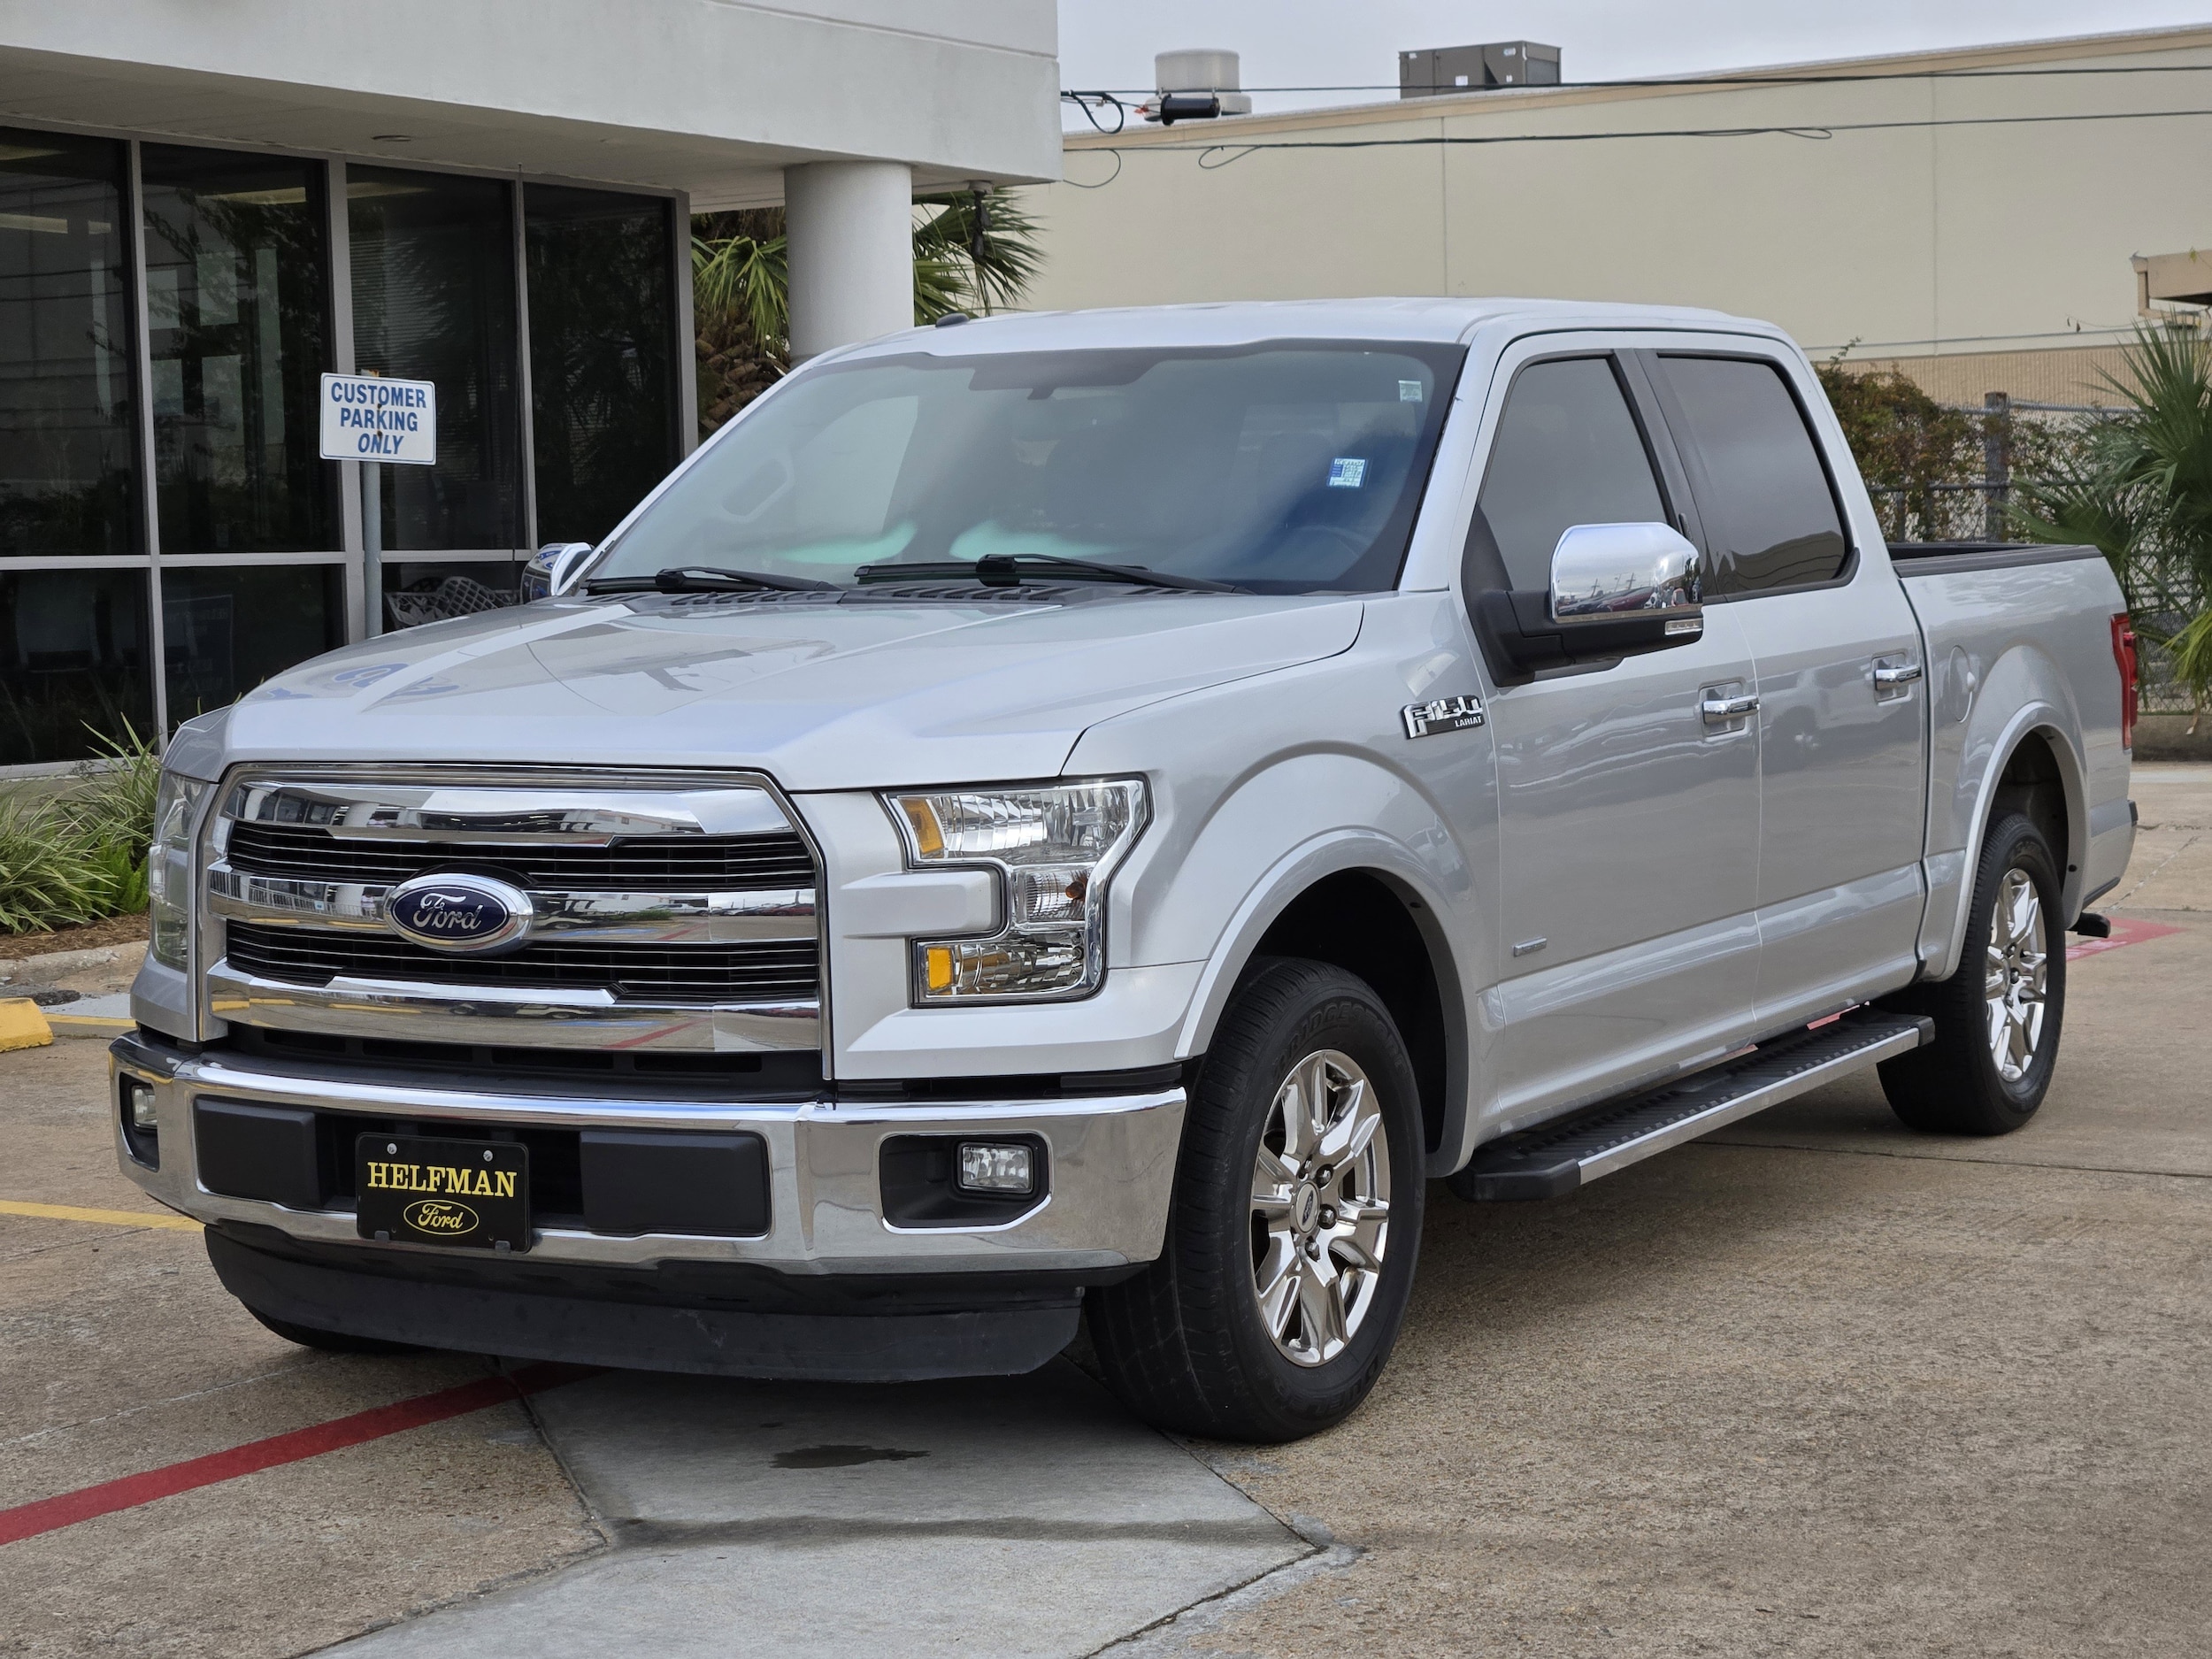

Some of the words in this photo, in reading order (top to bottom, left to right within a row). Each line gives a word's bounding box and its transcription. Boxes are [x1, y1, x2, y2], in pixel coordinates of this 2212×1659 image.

[331, 382, 426, 408] CUSTOMER
[341, 408, 418, 432] PARKING
[357, 433, 404, 454] ONLY
[1455, 716, 1481, 727] LARIAT
[413, 893, 483, 929] Ford
[367, 1162, 517, 1197] HELFMAN
[418, 1202, 464, 1229] Ford
